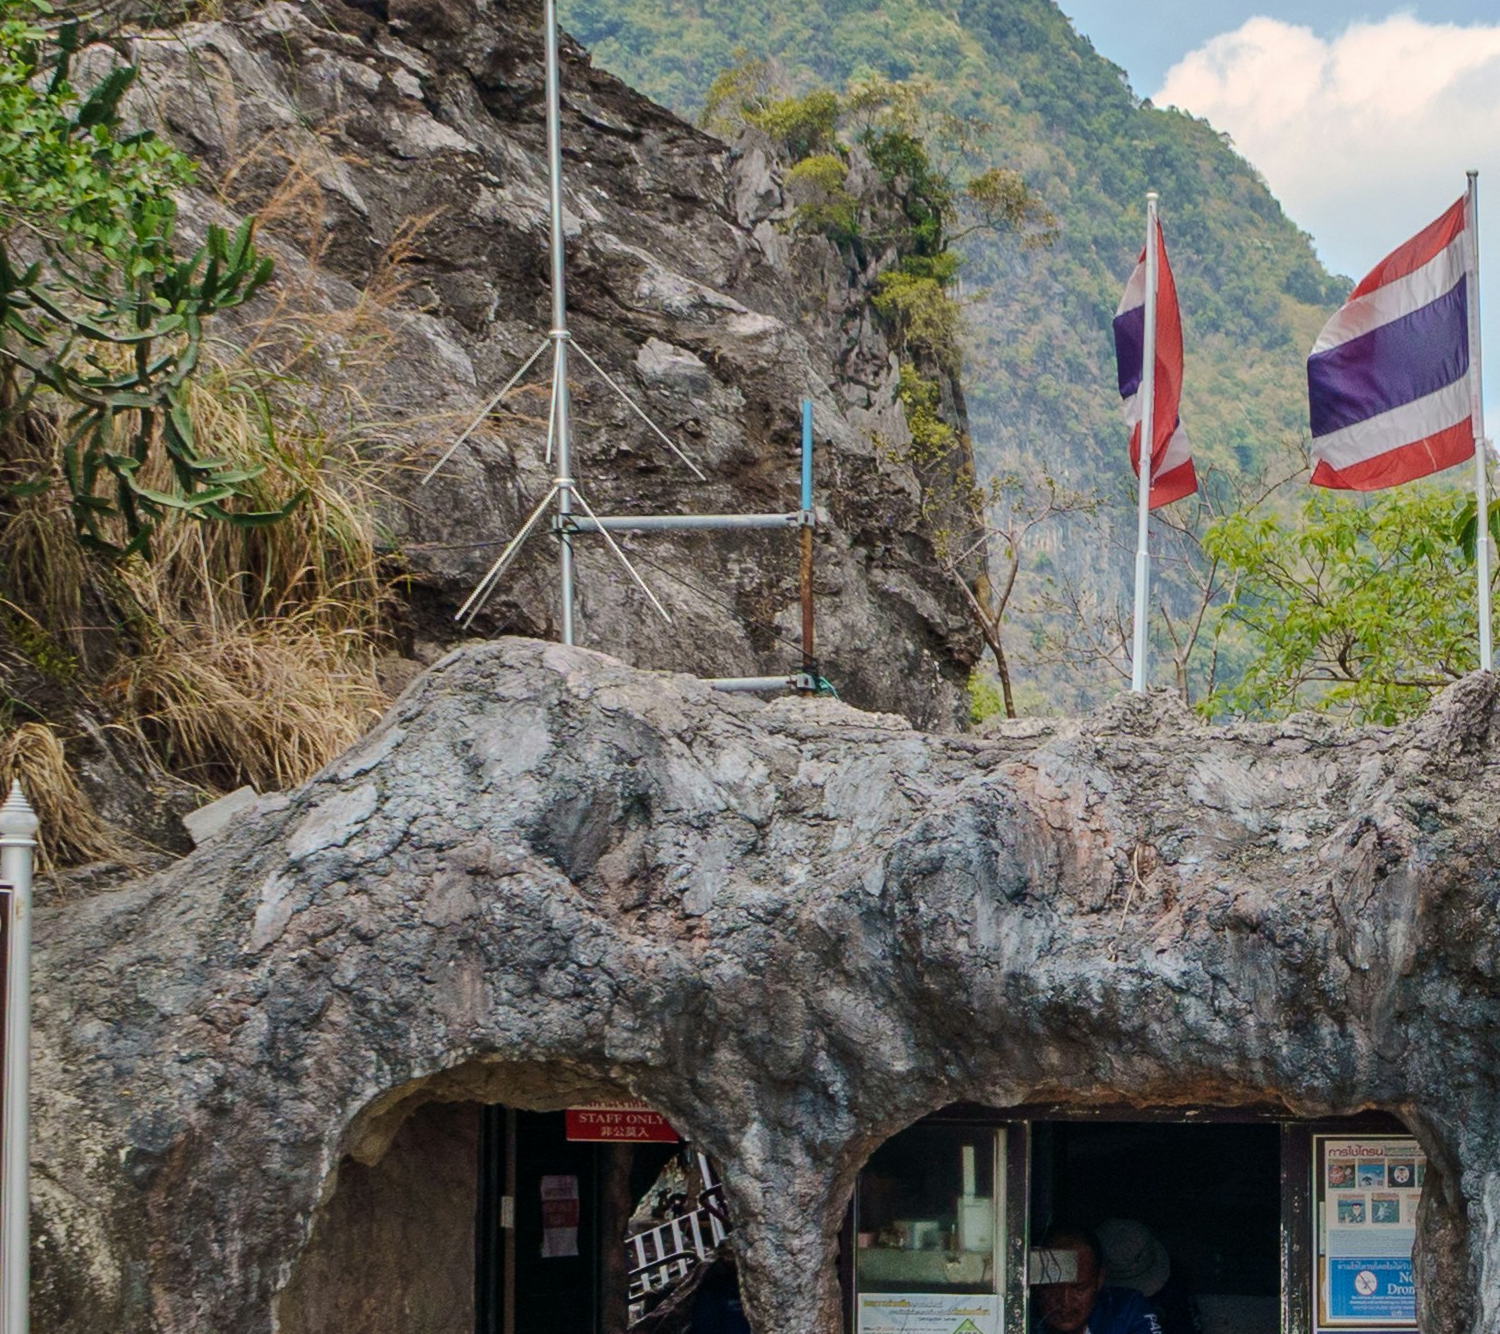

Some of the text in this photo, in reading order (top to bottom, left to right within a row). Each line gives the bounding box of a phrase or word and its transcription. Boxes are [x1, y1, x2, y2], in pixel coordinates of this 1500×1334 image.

[579, 1113, 664, 1125] STAFF ONLY
[1387, 1283, 1415, 1294] Dron
